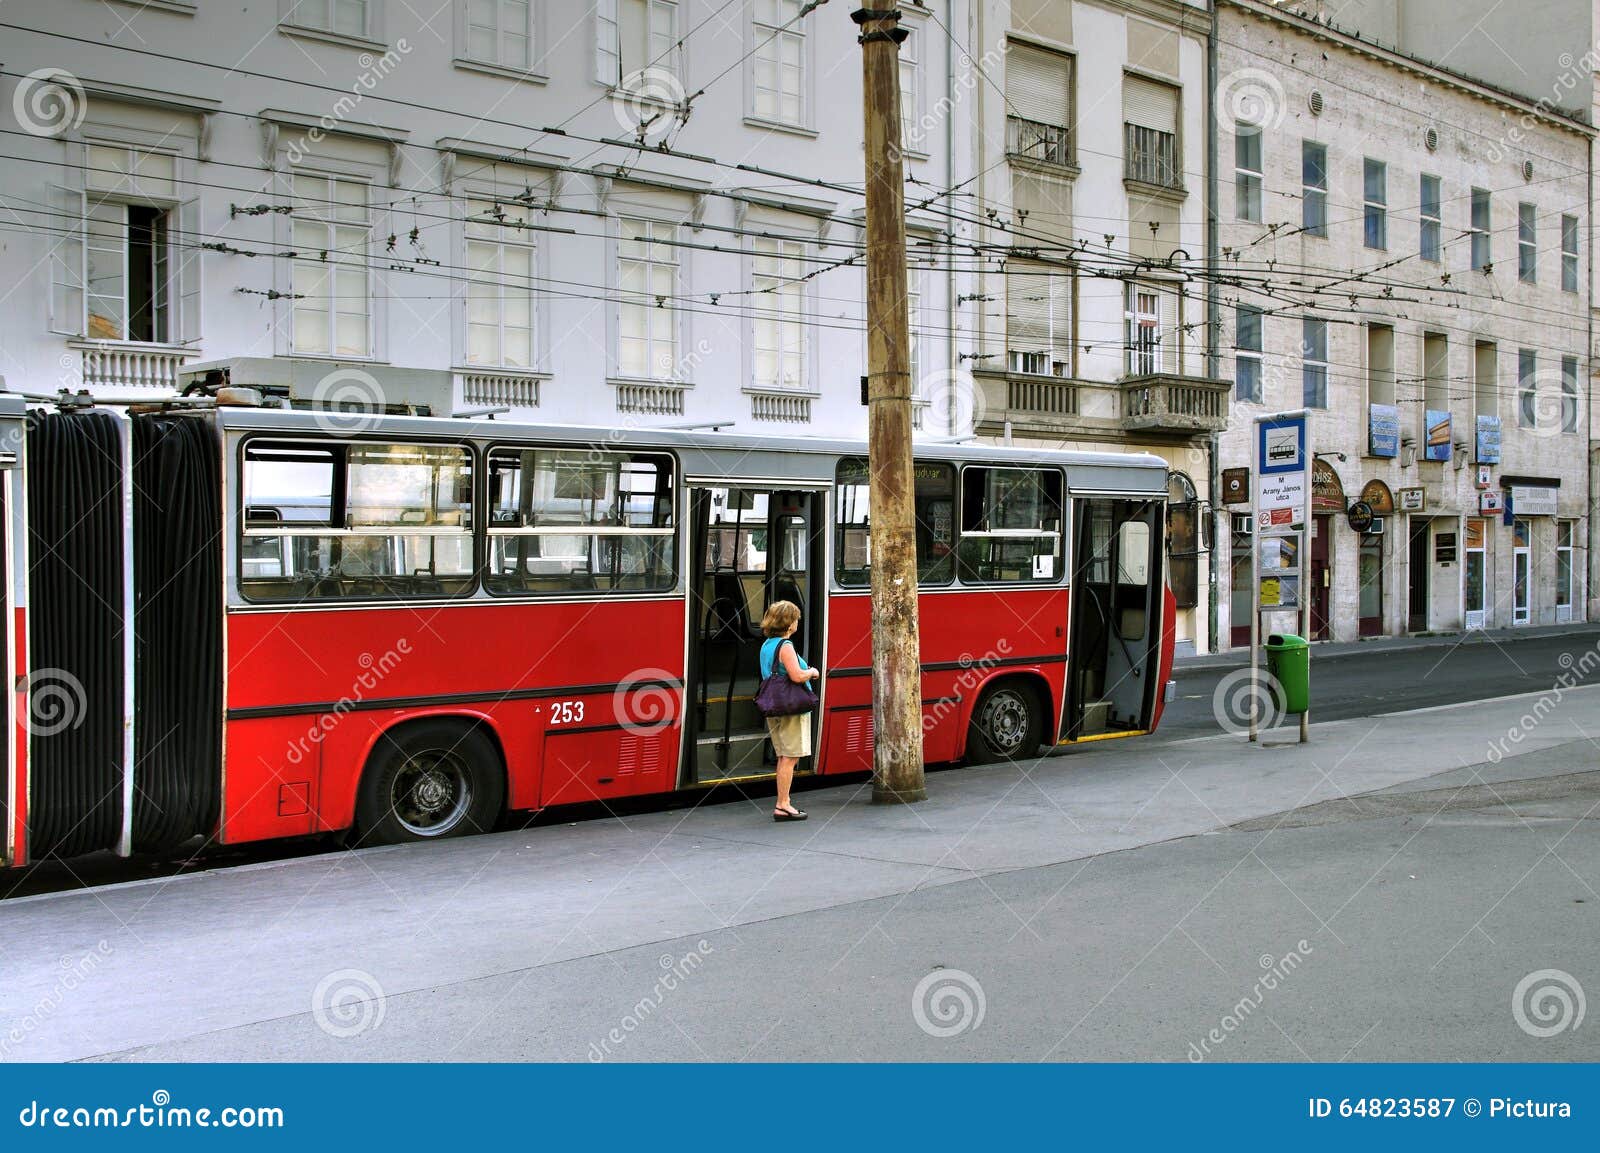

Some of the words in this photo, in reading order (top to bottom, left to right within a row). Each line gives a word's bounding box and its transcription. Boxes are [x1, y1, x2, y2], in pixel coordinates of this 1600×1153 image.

[1262, 488, 1281, 496] Arany
[1282, 485, 1301, 493] János
[550, 701, 585, 725] 253
